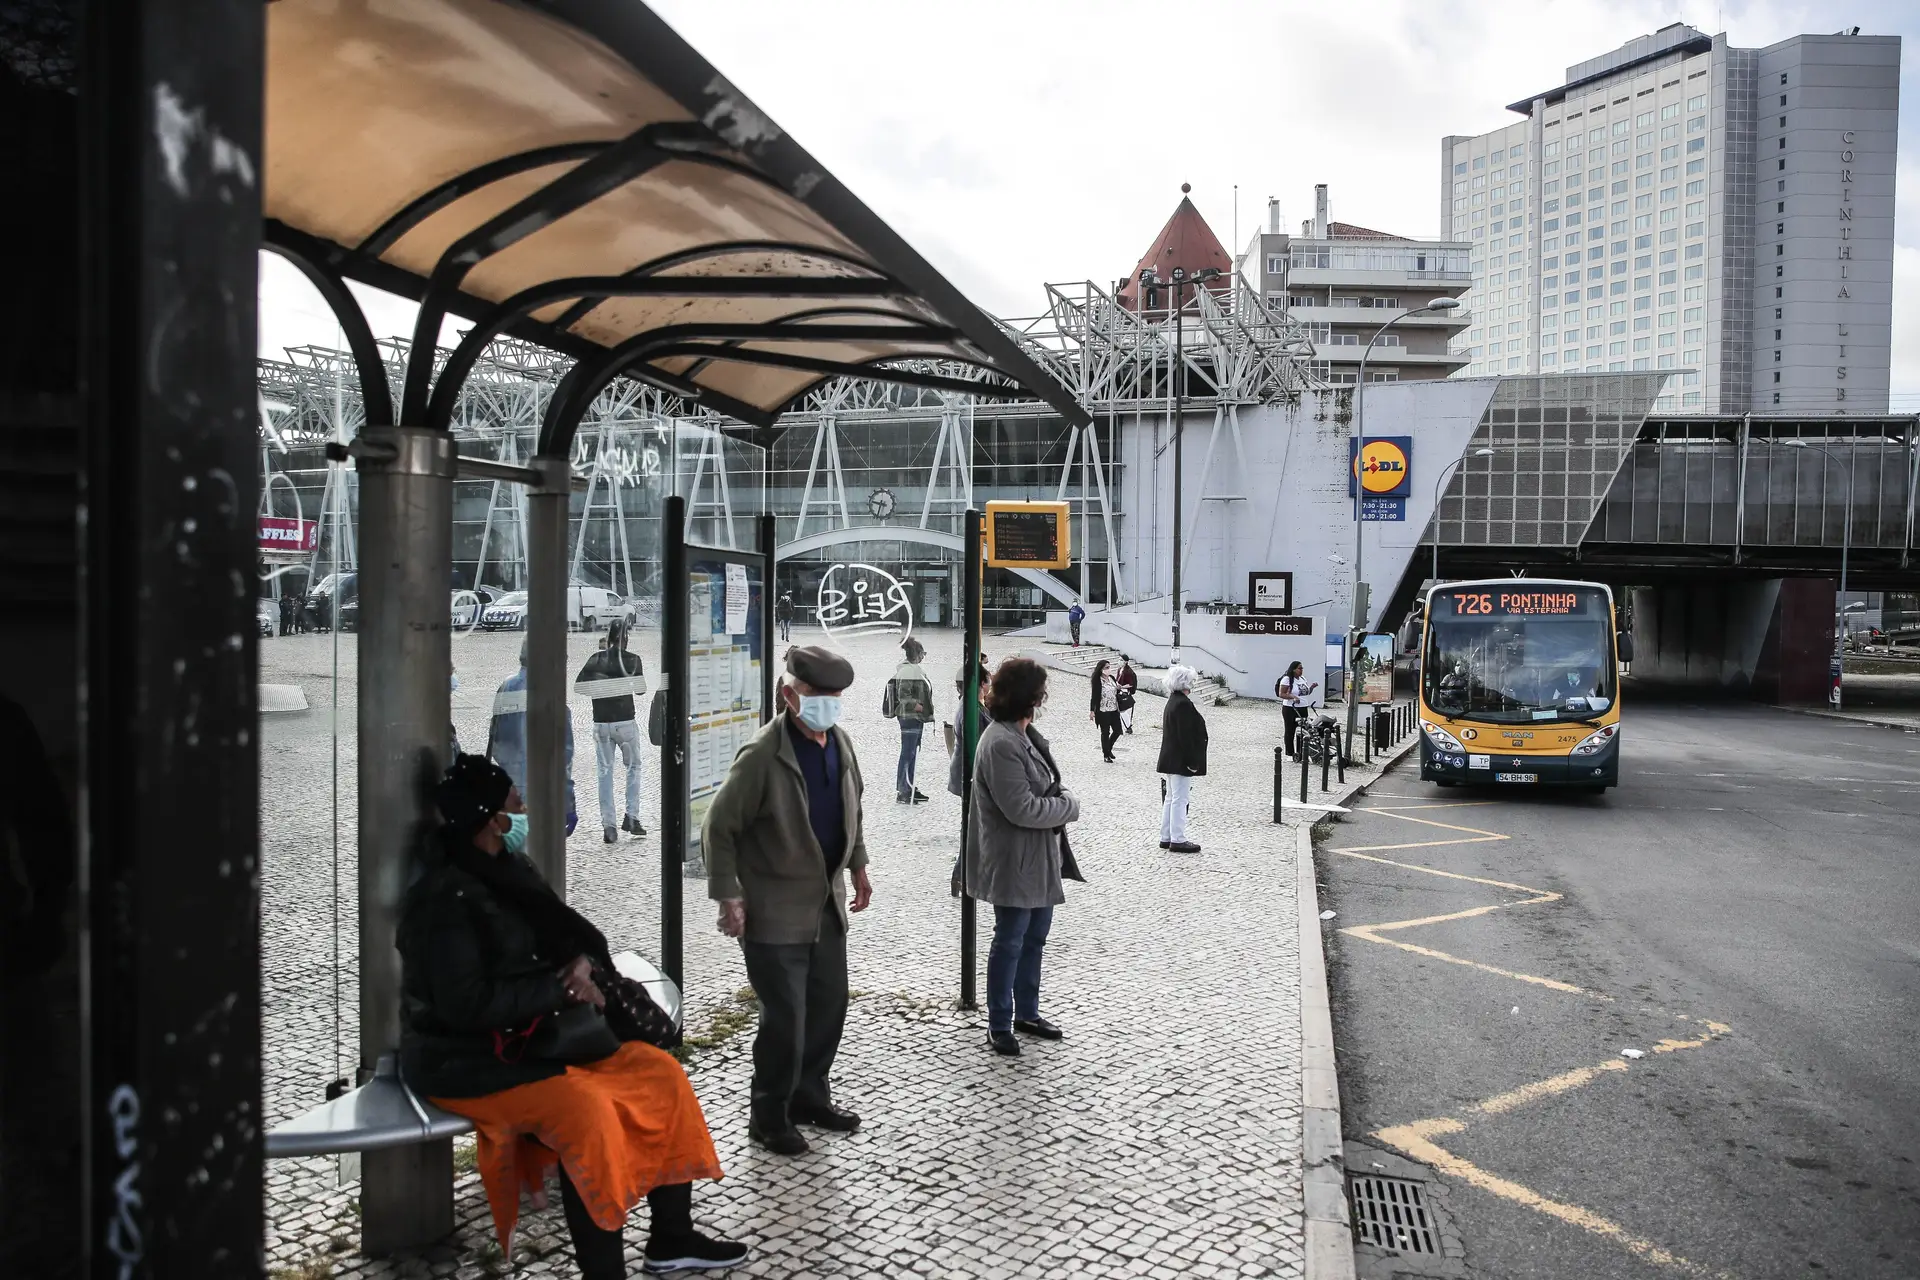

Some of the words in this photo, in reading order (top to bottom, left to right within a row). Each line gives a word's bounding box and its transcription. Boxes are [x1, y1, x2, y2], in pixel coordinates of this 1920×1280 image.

[1838, 131, 1855, 298] CORINTHIA
[1454, 593, 1493, 614] 726
[1501, 593, 1577, 608] PONTINHA
[1238, 620, 1265, 630] Sete
[1274, 620, 1299, 631] Rios
[1502, 731, 1533, 739] MAN
